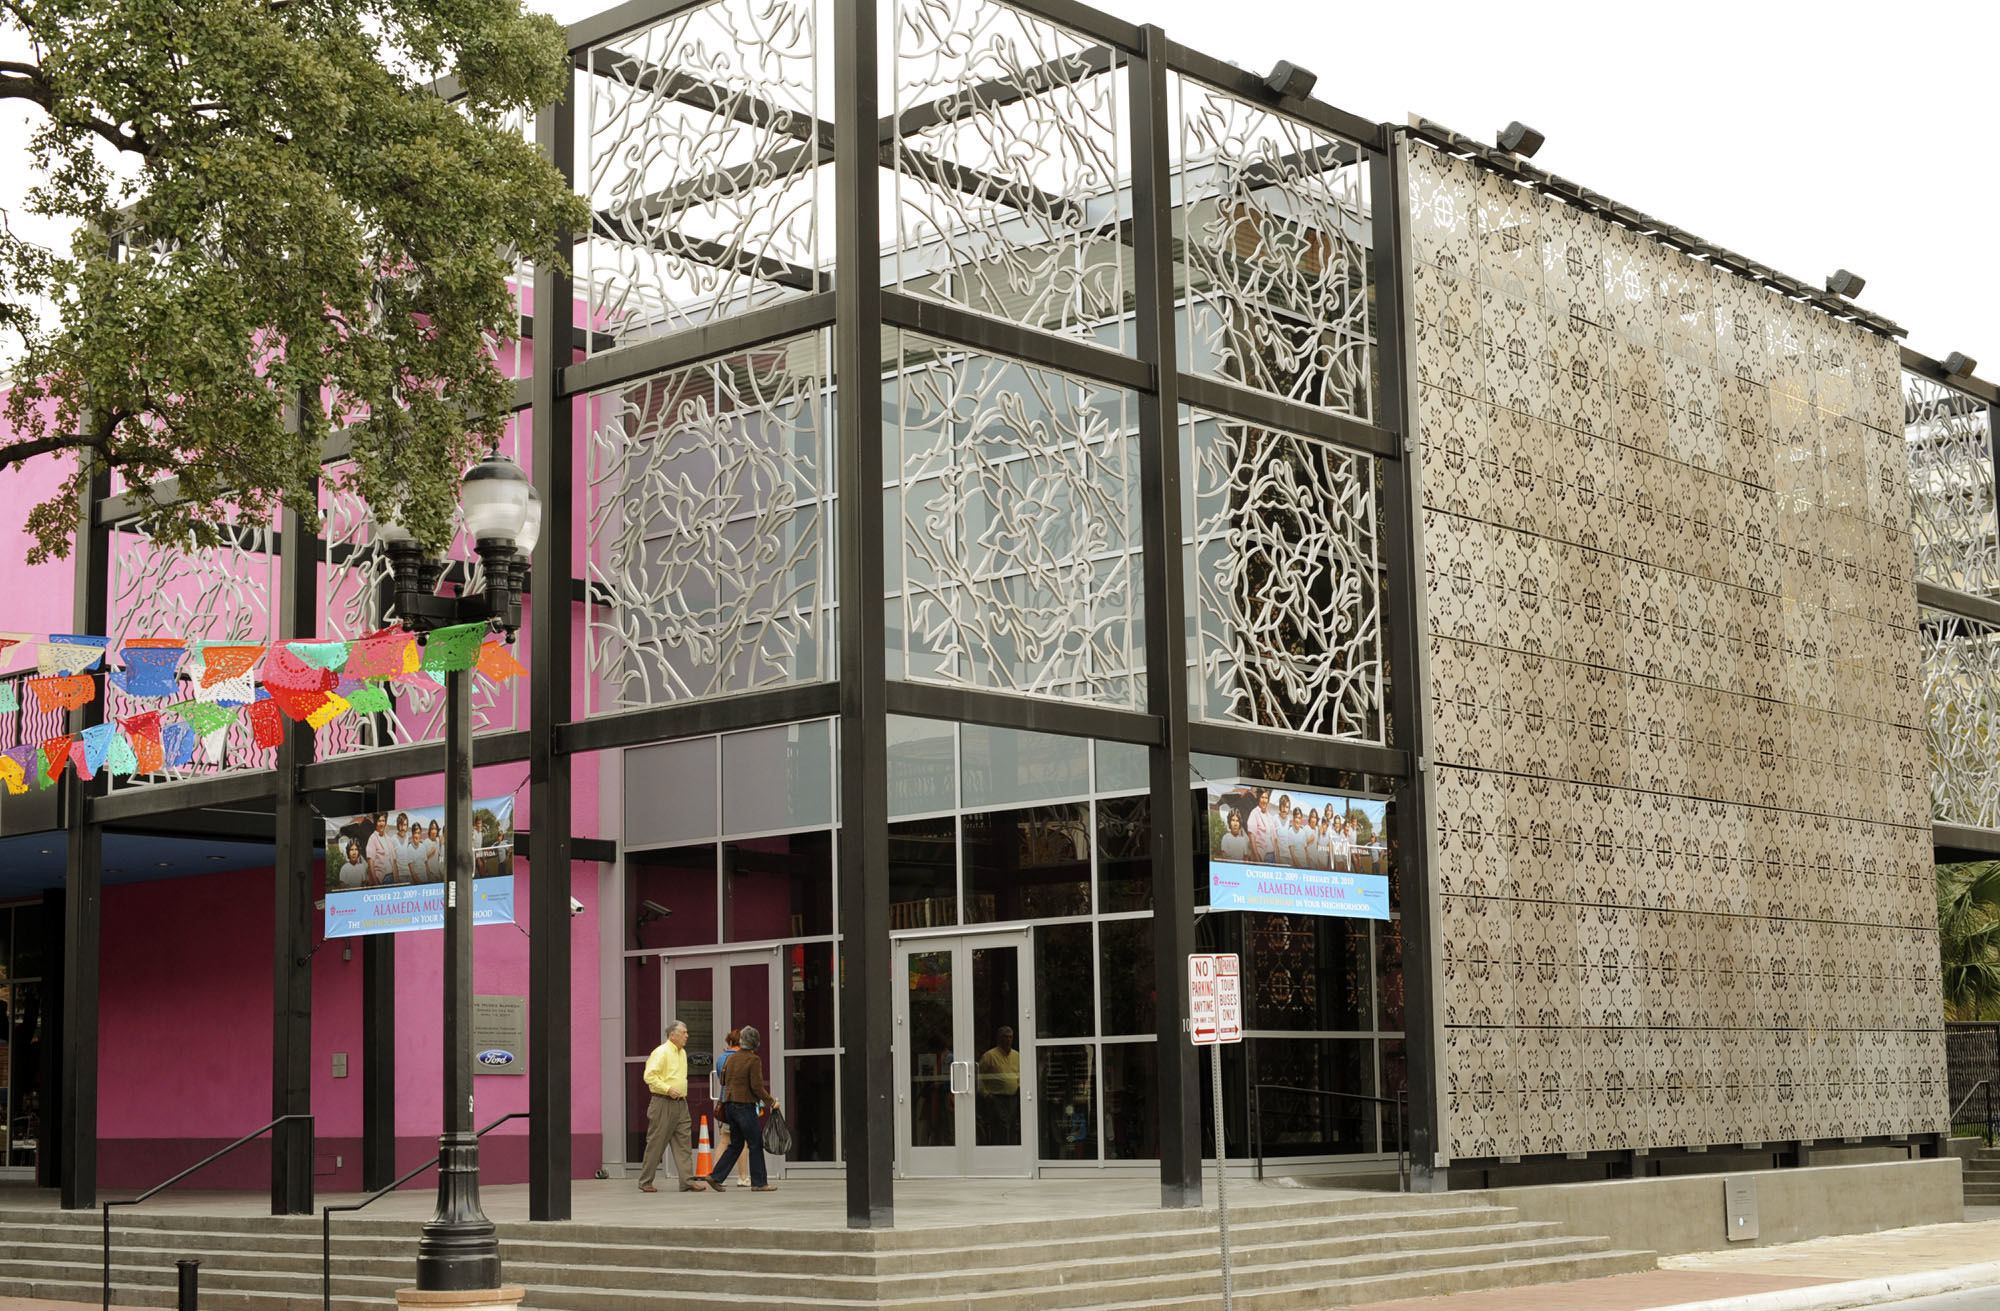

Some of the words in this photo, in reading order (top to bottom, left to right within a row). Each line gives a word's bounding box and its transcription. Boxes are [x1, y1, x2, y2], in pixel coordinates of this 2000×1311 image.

[1246, 869, 1274, 879] OCTOBER
[1285, 871, 1299, 881] 2009
[1303, 873, 1331, 884] FEBRUARY
[1341, 876, 1355, 886] 2010
[363, 890, 392, 903] OCTOBER
[403, 889, 418, 900] 2009
[422, 887, 444, 898] FEBRUA
[1257, 881, 1303, 897] ALAMEDA
[1304, 885, 1345, 899] MUSEUM
[373, 900, 421, 917] ALAMEDA
[423, 897, 444, 912] MUS
[1232, 893, 1246, 904] THE
[1304, 899, 1321, 908] YOUR
[1321, 901, 1370, 912] NEIGHBORHOOD
[348, 920, 360, 929] THE
[412, 916, 420, 924] IN
[420, 914, 438, 924] YOUR
[1195, 960, 1209, 977] NO
[1192, 980, 1214, 997] PARKING
[1221, 979, 1235, 991] TOUR
[1194, 1000, 1214, 1013] ANYTIME
[1219, 993, 1237, 1006] BUSES
[1222, 1008, 1236, 1021] ONLY
[484, 1052, 507, 1064] Ford
